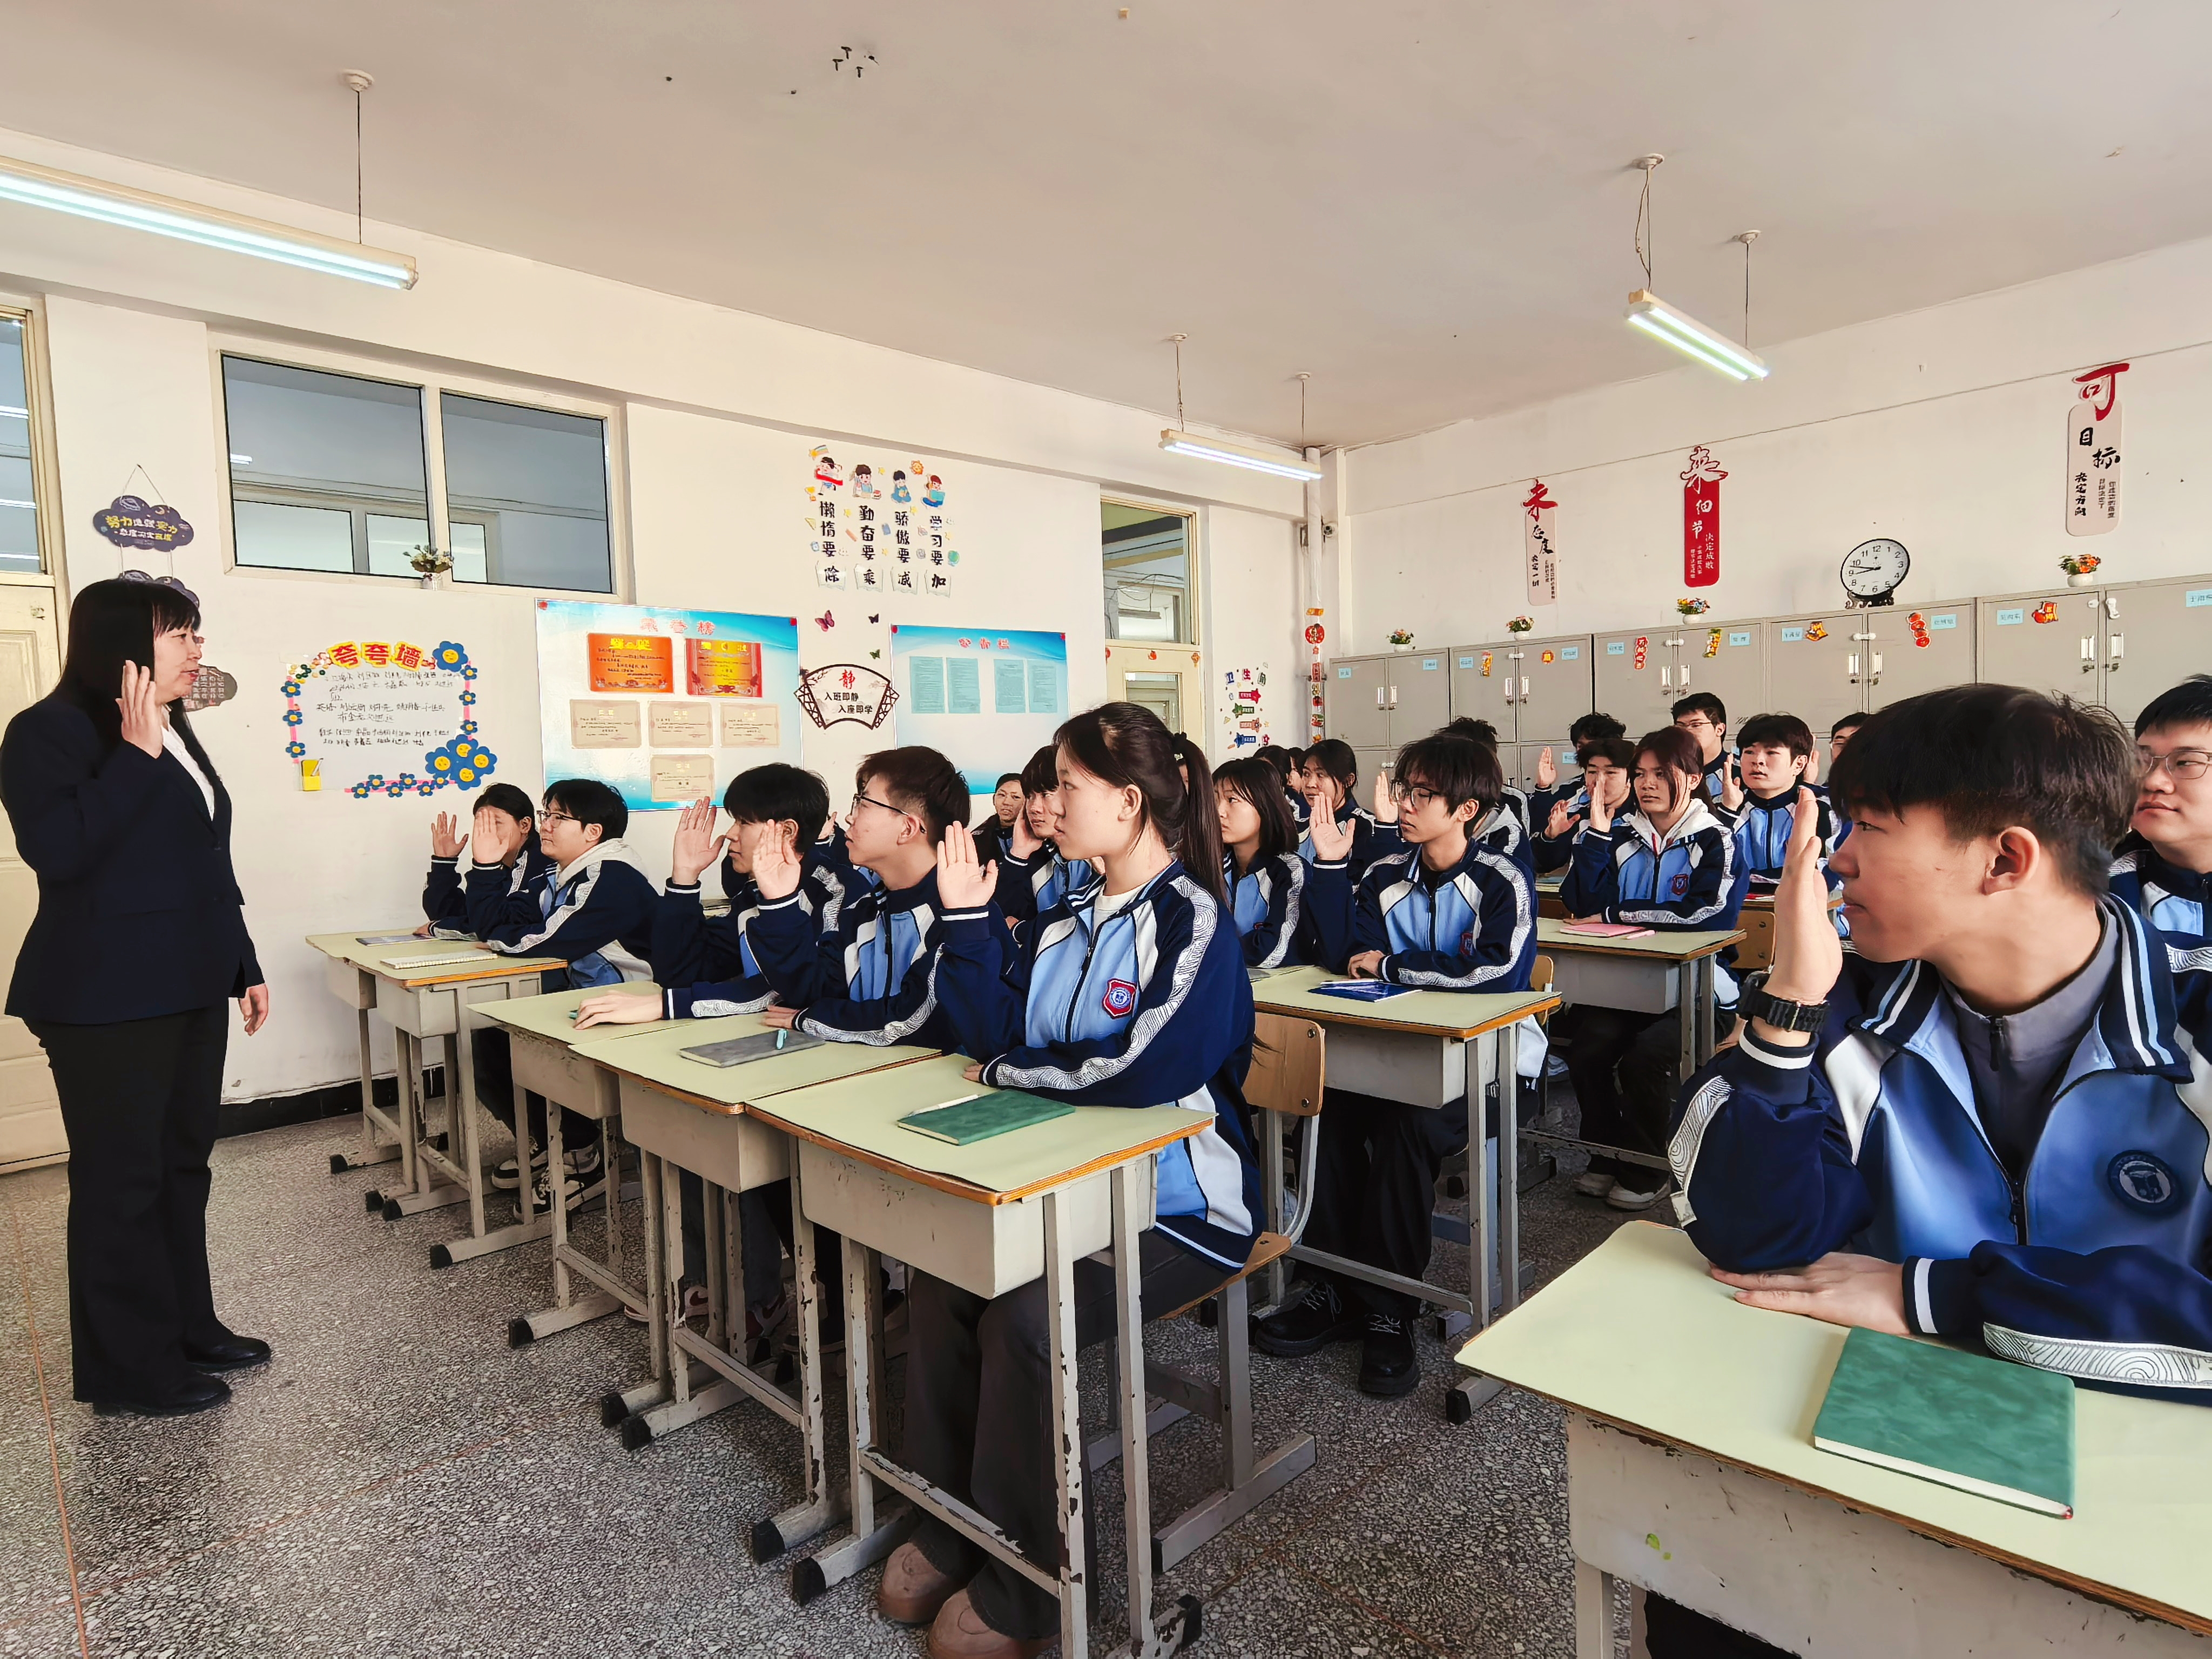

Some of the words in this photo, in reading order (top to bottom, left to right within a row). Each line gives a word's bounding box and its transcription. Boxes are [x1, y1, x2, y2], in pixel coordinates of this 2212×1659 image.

[2072, 362, 2130, 421] 可
[2079, 427, 2120, 469] 目标
[1680, 446, 1728, 494] 来
[2074, 472, 2088, 516] 决定方向
[1531, 524, 1554, 556] 态度
[1691, 500, 1713, 539] 细节
[820, 501, 839, 583] 懒惰要除
[858, 505, 876, 585] 勤奋要乘
[894, 511, 912, 588] 骄傲要减
[929, 515, 946, 588] 学习要加
[1705, 532, 1715, 570] 决定成败
[333, 642, 422, 669] 夸夸墙
[824, 691, 859, 702] 入班即静
[838, 669, 856, 690] 静
[838, 704, 873, 715] 入座即学
